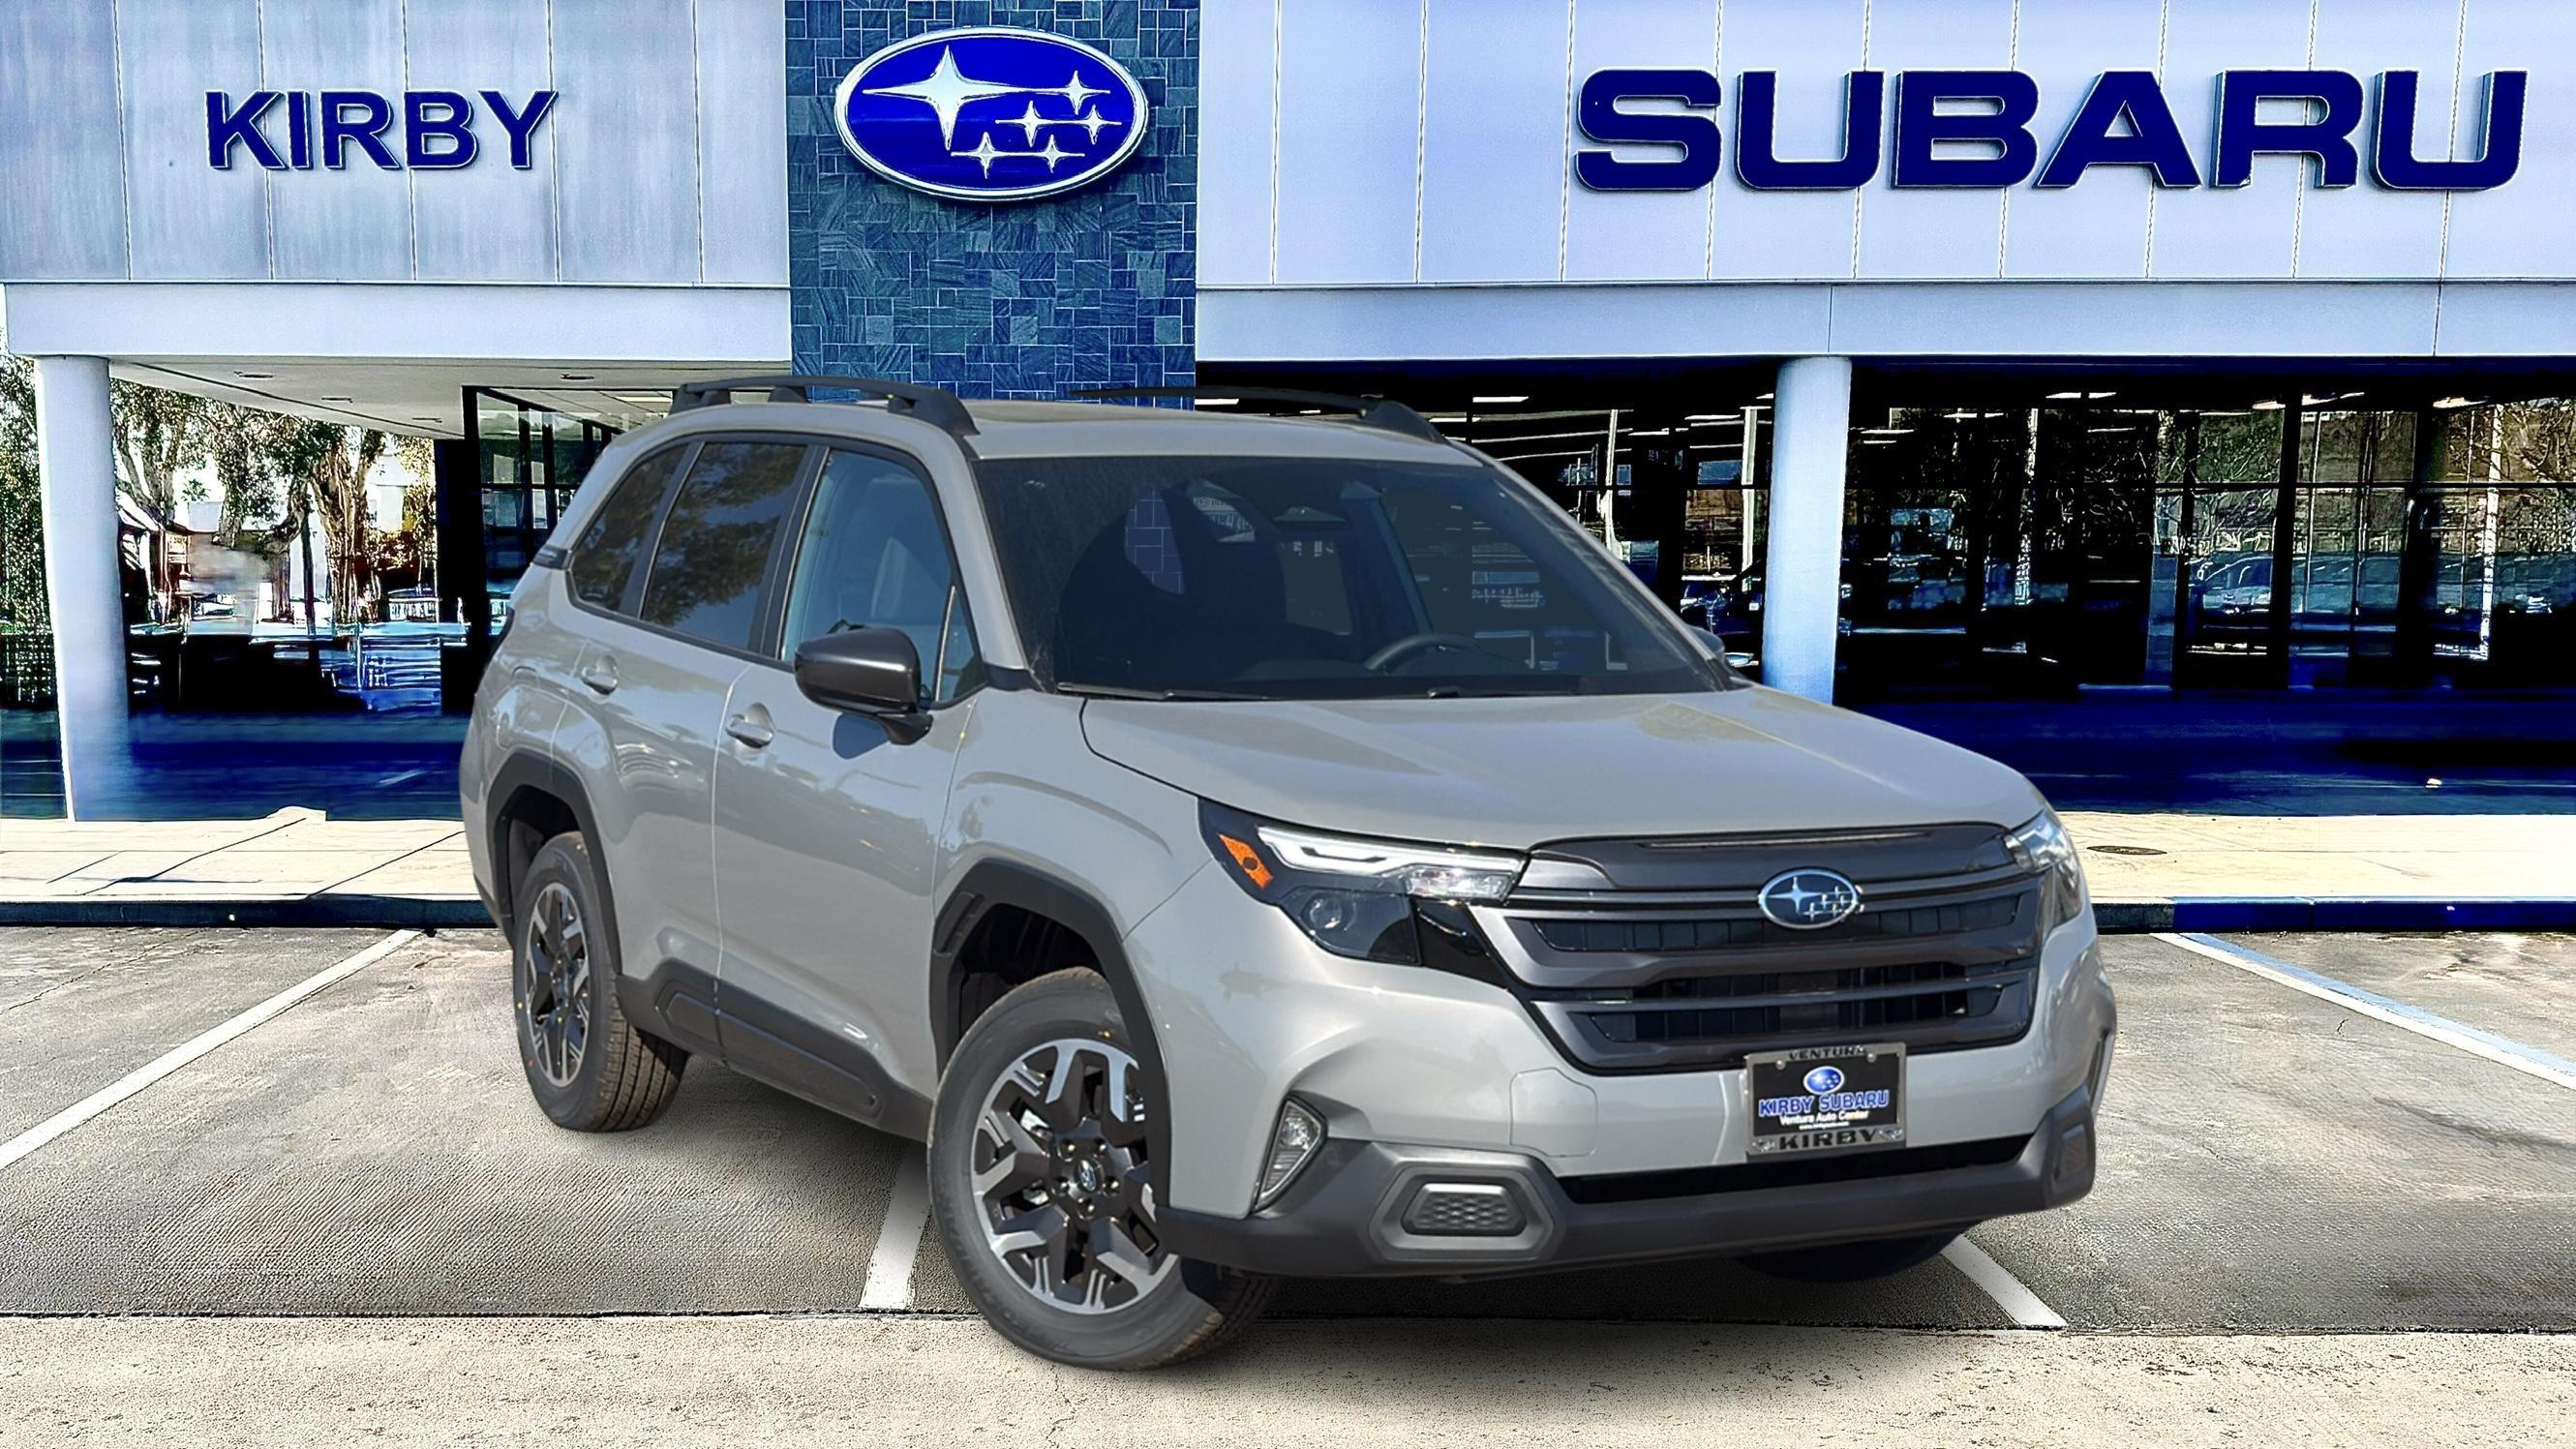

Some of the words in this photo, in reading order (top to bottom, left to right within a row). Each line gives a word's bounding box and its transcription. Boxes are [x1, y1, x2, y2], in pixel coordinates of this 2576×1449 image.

[204, 89, 558, 169] KIRBY
[1574, 69, 2528, 192] SUBARU
[1789, 1044, 1867, 1060] VENTURA
[1758, 1095, 1814, 1117] KIRBY
[1819, 1090, 1890, 1112] SUBARU
[1816, 1111, 1837, 1122] Auto
[1778, 1128, 1878, 1151] KIRBY
